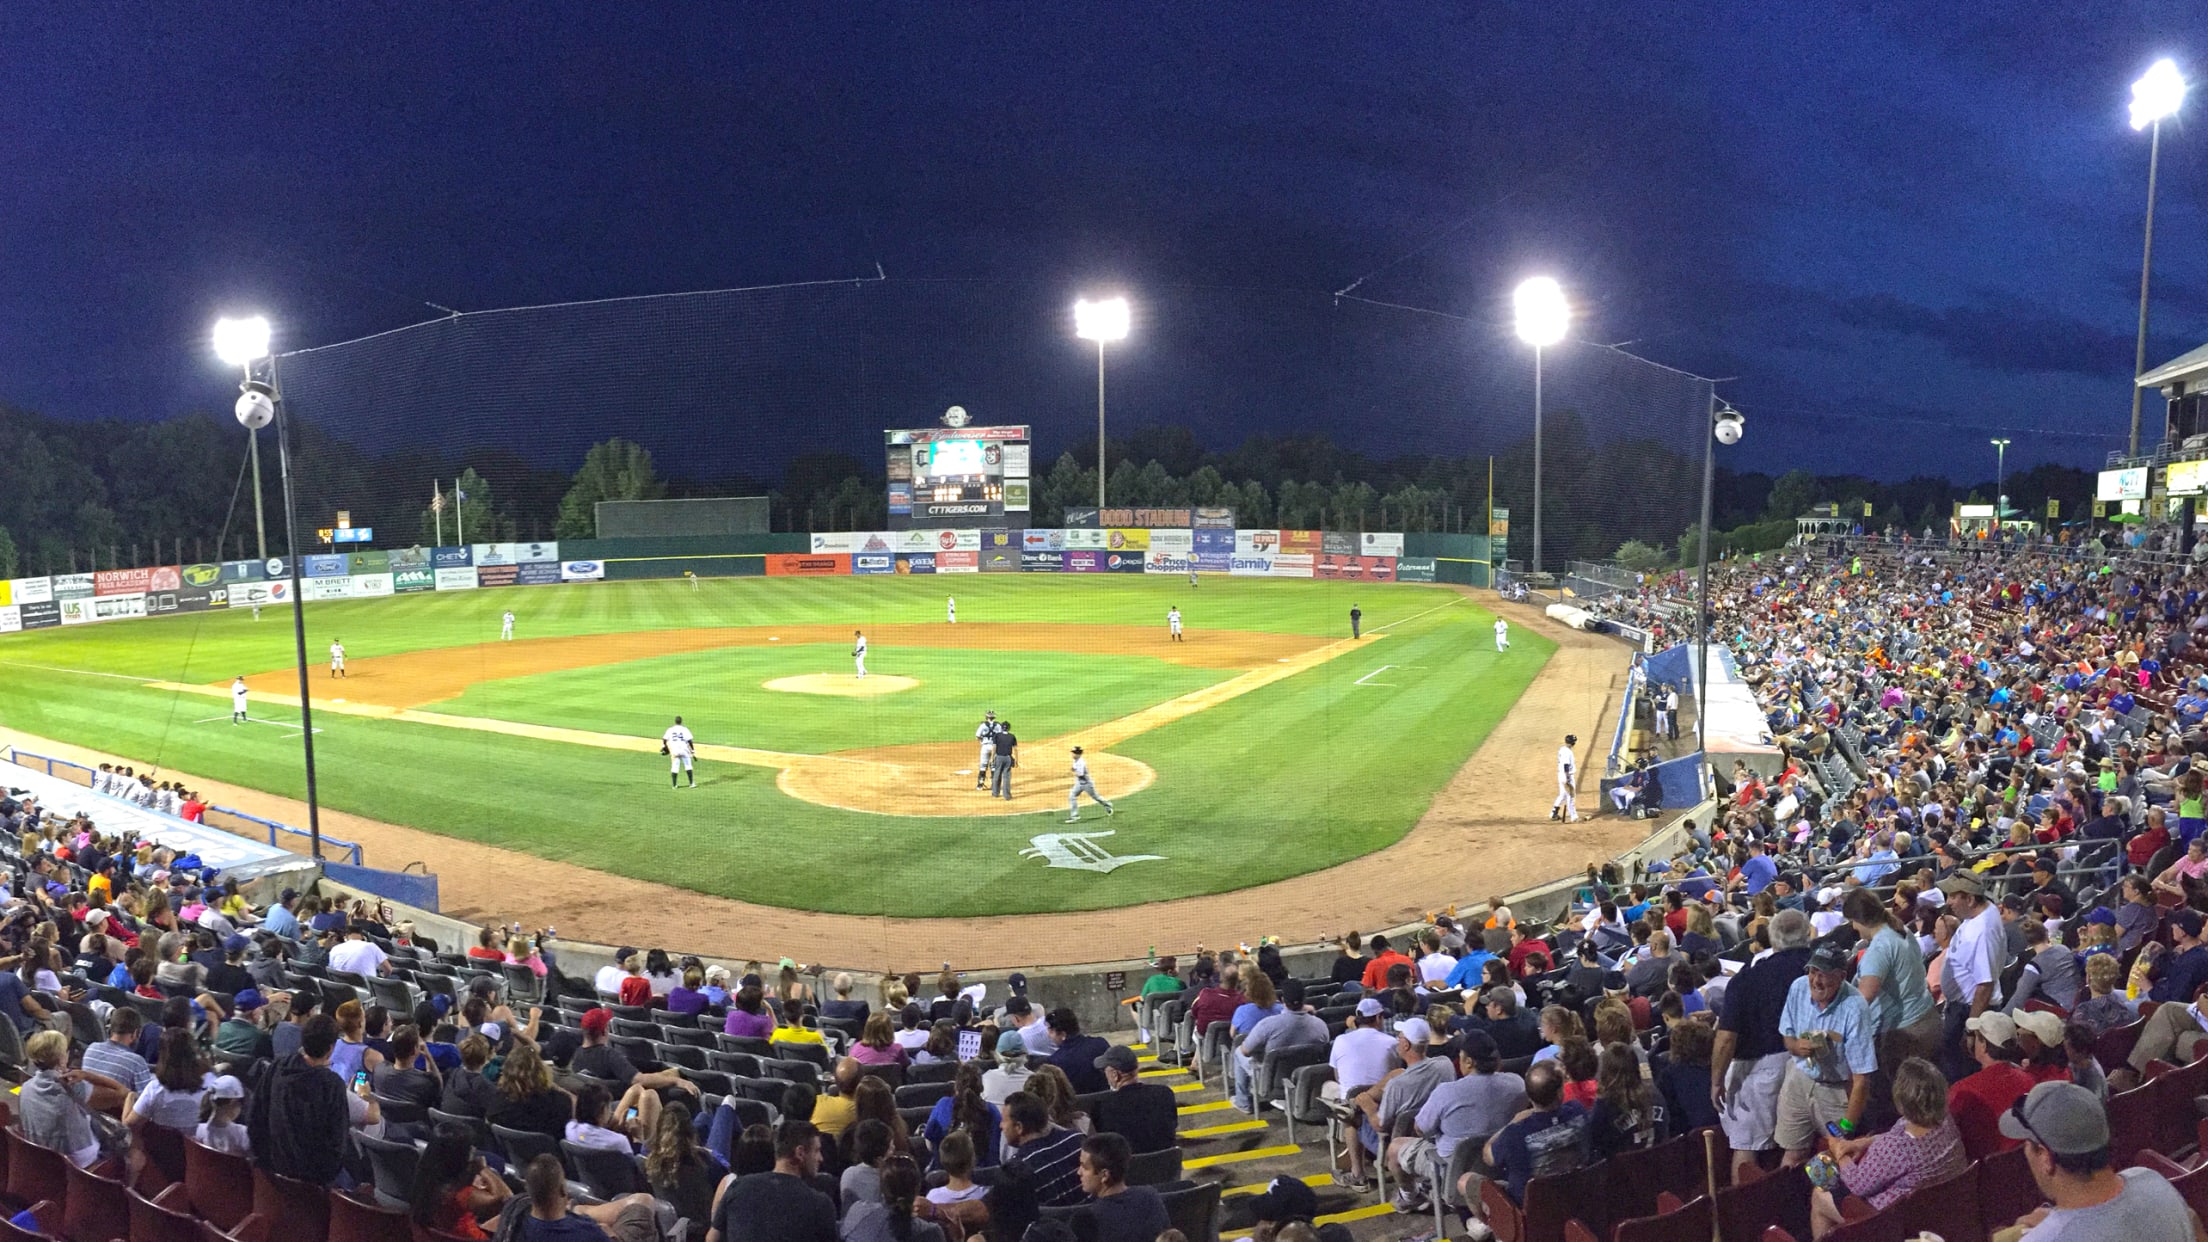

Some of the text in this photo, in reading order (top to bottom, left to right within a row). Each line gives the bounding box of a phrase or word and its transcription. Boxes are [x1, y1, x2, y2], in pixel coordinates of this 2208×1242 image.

[1099, 509, 1133, 527] DODD
[1135, 509, 1190, 527] STADIUM
[1122, 558, 1143, 566] pepsi
[1146, 562, 1186, 572] Chopper
[1163, 557, 1187, 565] Price
[1231, 557, 1272, 571] family
[97, 569, 149, 583] NORWICH
